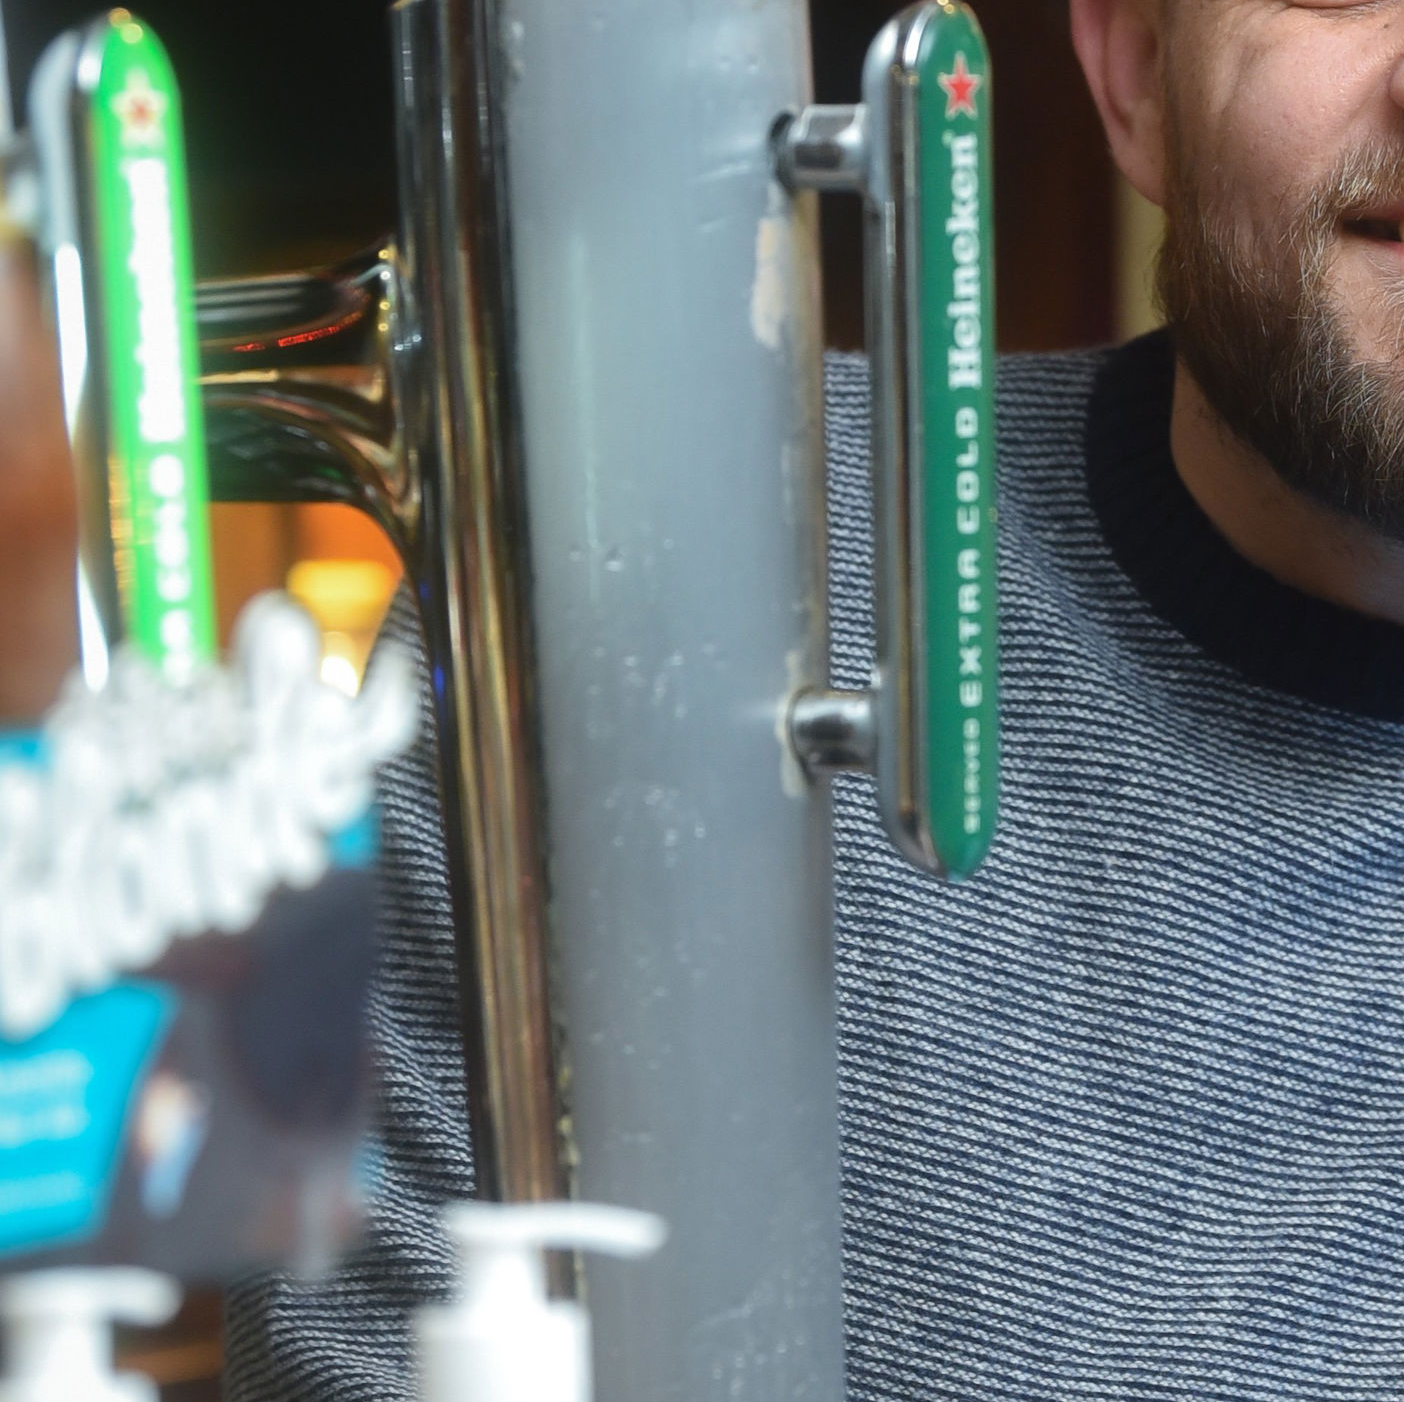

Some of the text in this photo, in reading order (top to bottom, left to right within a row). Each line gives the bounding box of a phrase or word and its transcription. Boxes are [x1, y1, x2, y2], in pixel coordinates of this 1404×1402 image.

[945, 132, 983, 389] Heineken
[955, 406, 981, 535] COLD
[957, 548, 983, 708] EXTRA
